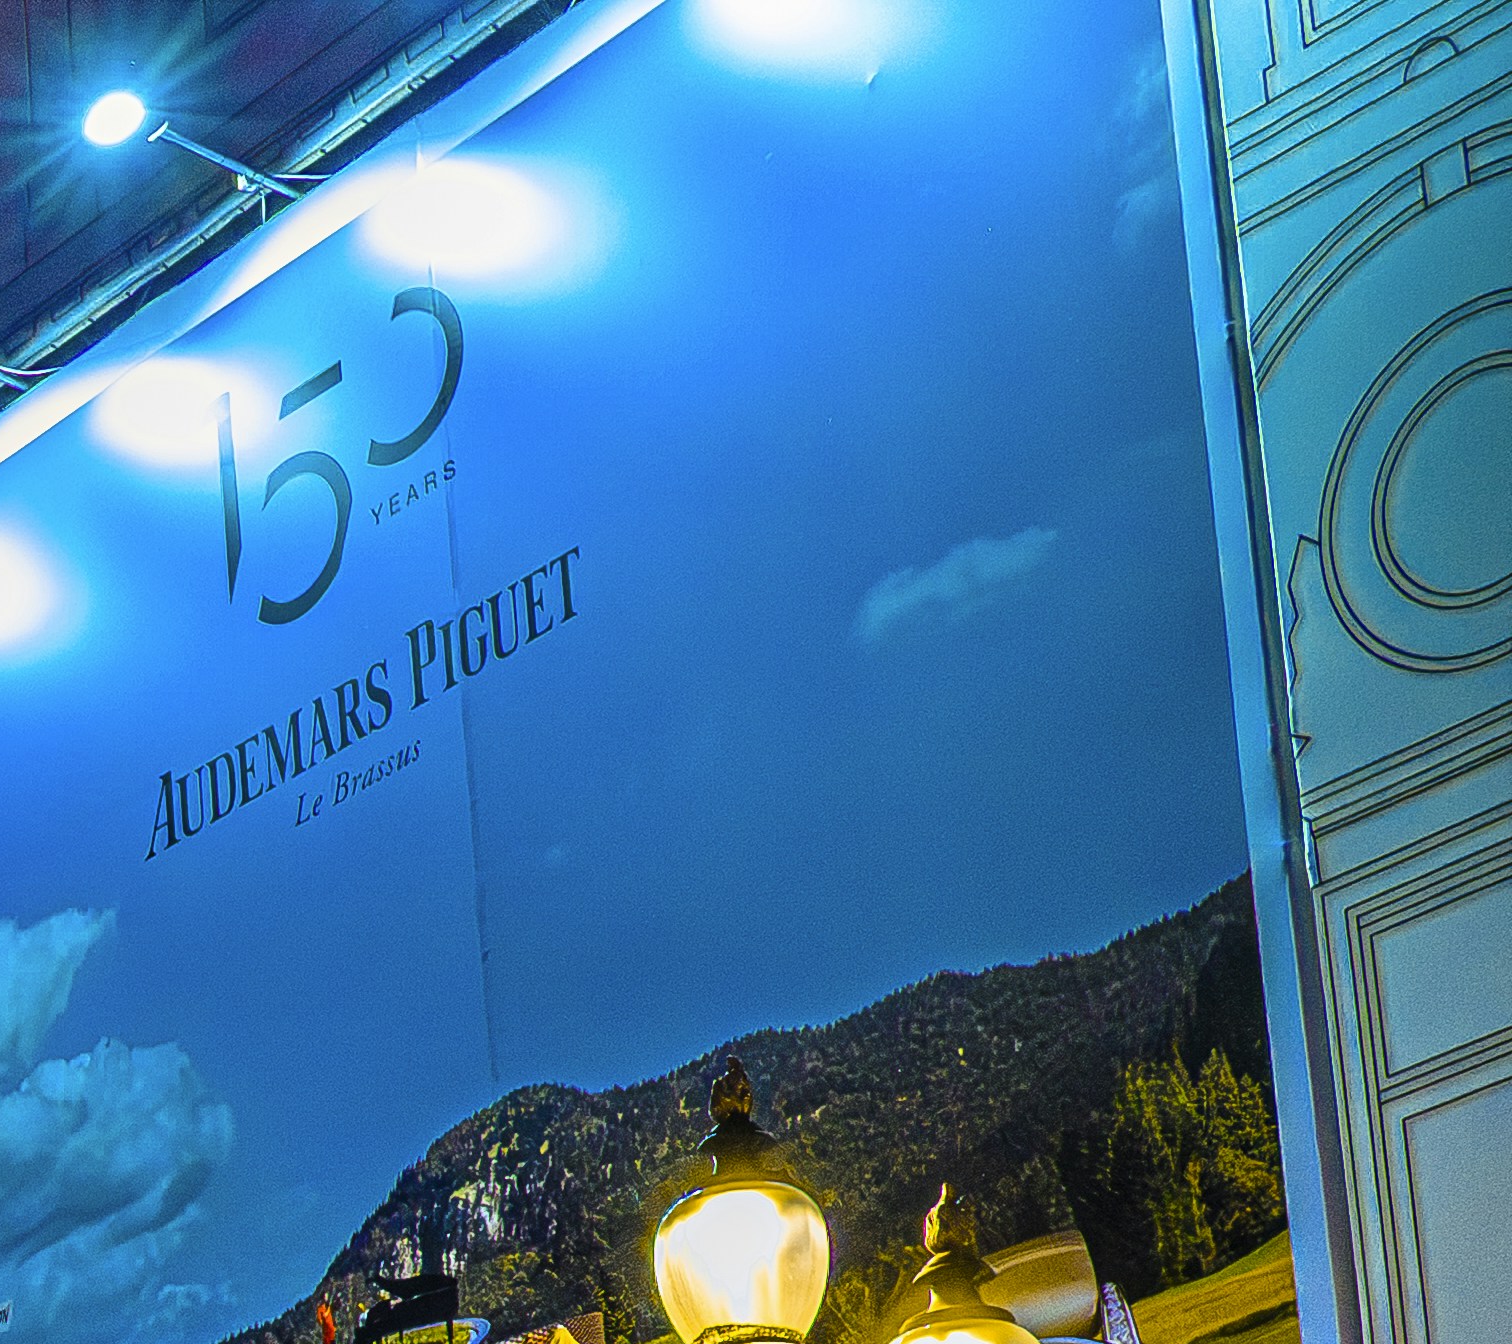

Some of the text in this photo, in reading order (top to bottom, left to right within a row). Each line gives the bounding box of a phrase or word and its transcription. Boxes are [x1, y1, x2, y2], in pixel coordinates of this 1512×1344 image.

[369, 459, 458, 526] YEARS
[144, 546, 581, 861] AUDEMARS PIGUET
[295, 738, 422, 828] Le Brassus
